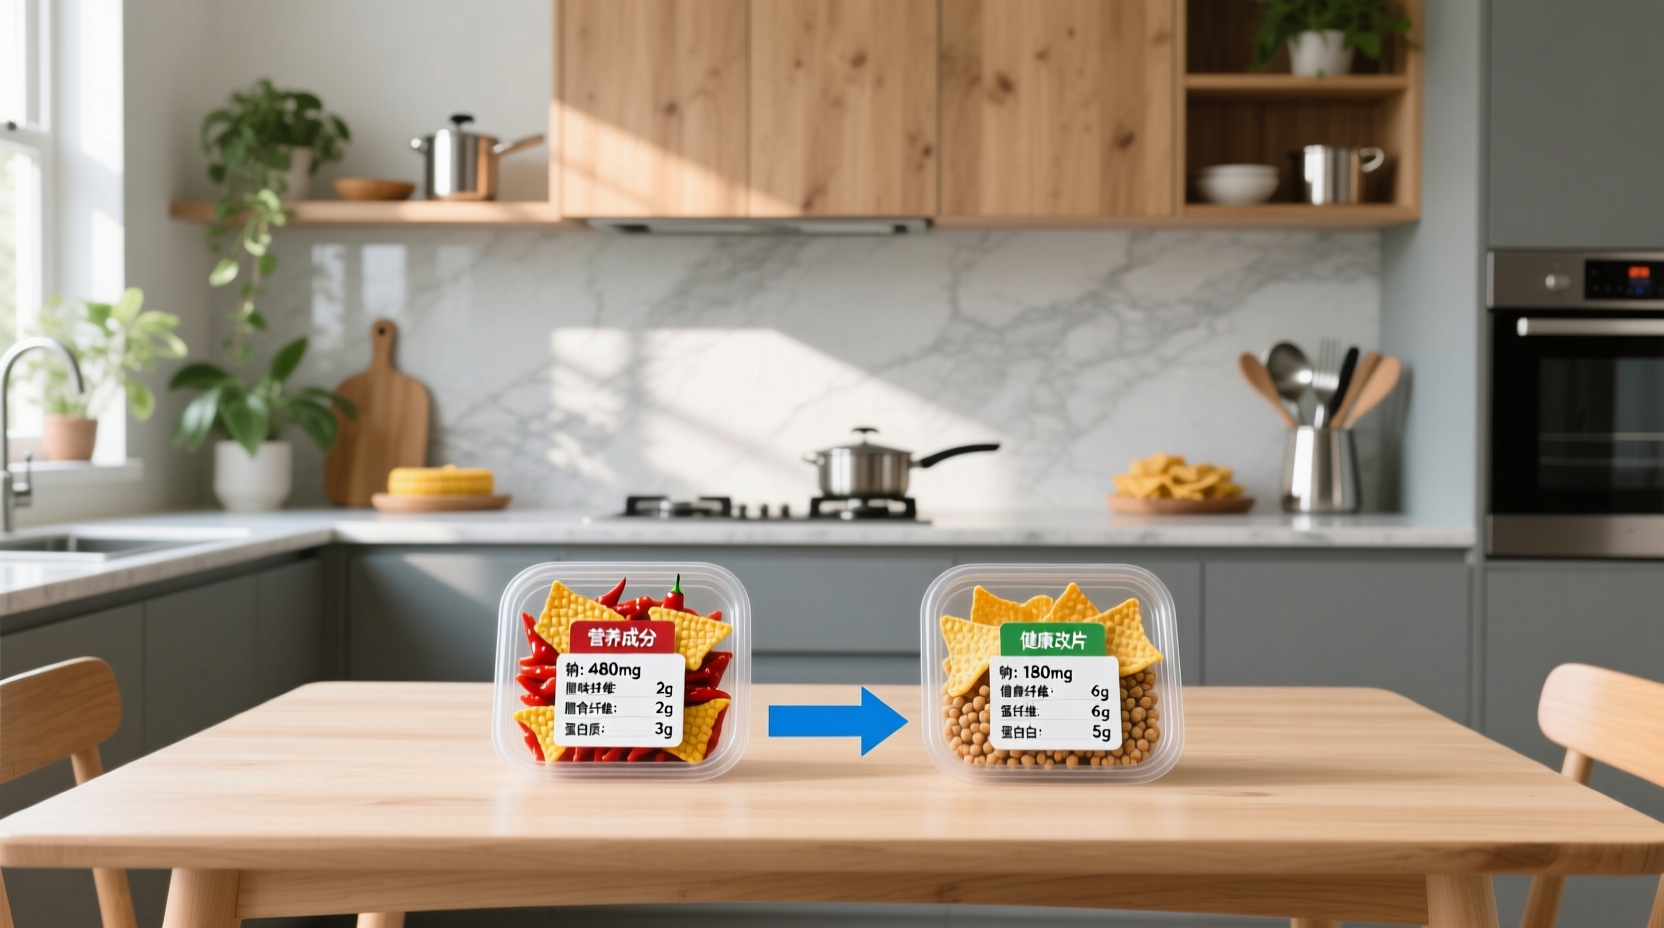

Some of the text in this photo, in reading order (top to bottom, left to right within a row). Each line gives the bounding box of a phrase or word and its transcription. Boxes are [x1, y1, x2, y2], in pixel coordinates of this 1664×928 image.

[587, 627, 657, 648] 营养成分
[588, 662, 641, 680] 480mg
[1023, 665, 1073, 683] 180mg
[656, 681, 673, 698] 2g
[1091, 685, 1109, 701] 6g
[655, 701, 673, 717] 2g
[1091, 705, 1110, 721] 6g
[655, 722, 673, 739] 3g
[1092, 725, 1111, 742] 5g
